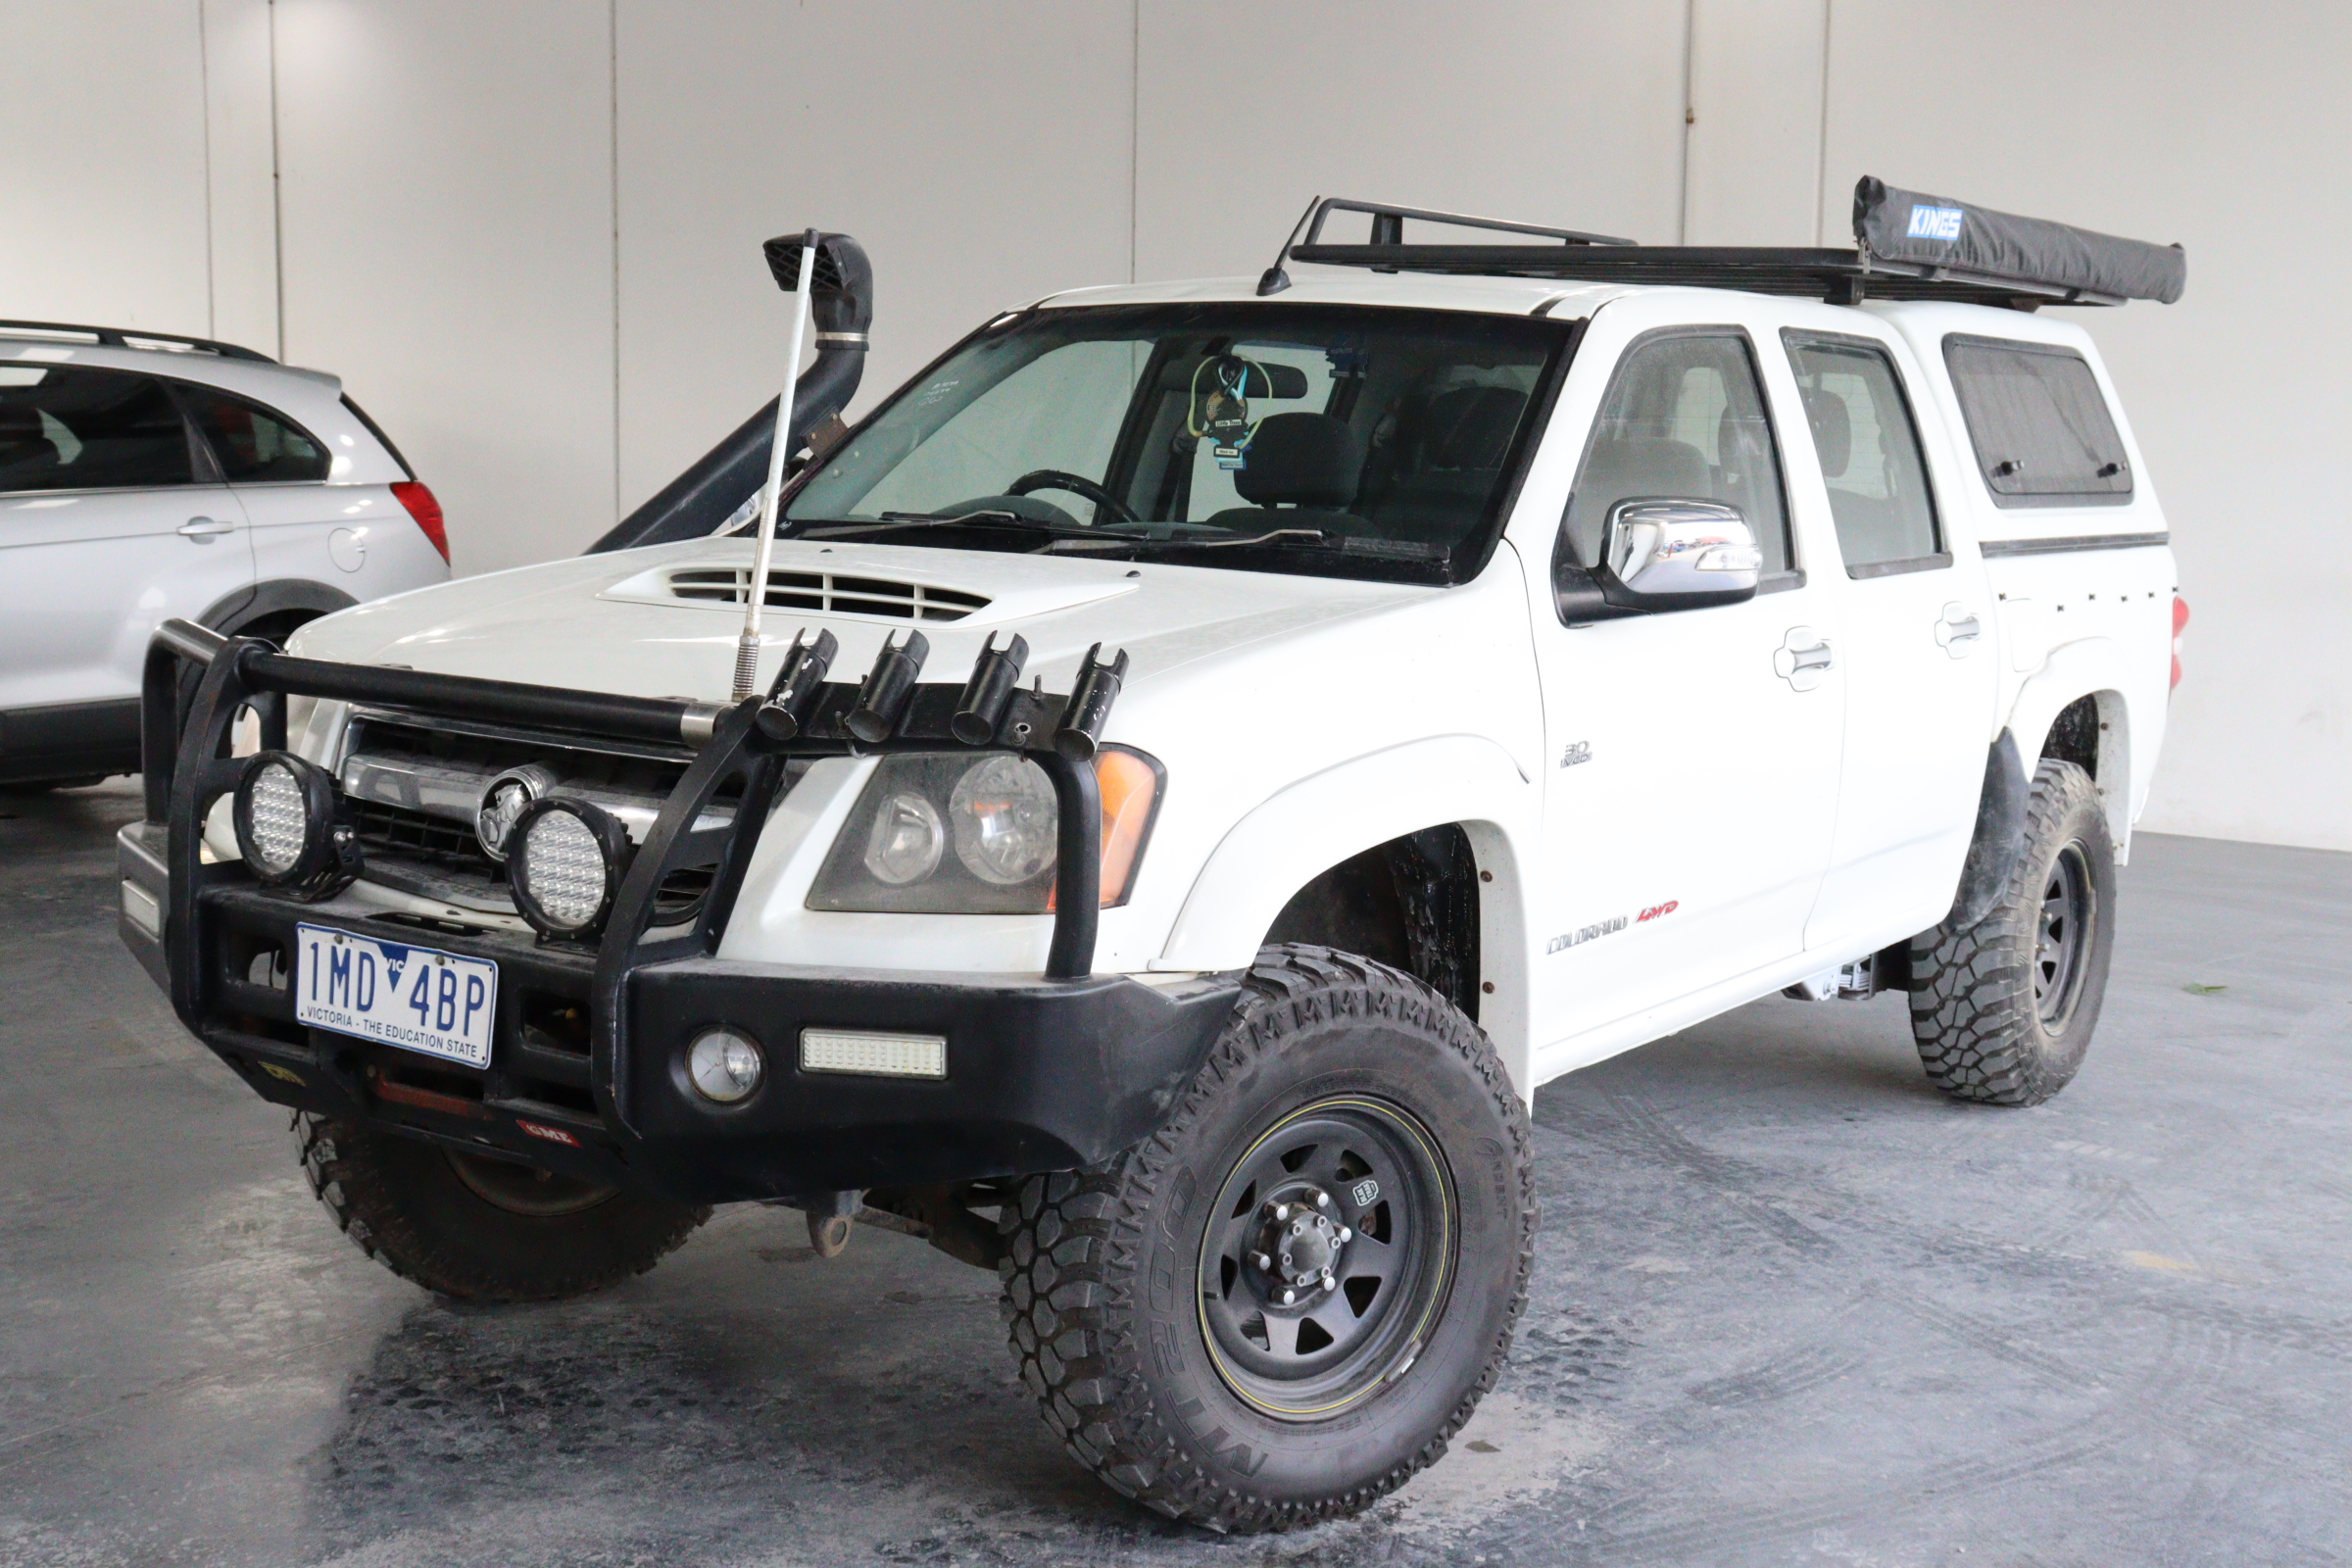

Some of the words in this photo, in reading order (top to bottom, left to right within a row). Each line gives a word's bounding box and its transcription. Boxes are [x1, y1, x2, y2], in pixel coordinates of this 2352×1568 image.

[1908, 208, 1961, 237] KINGS
[1546, 914, 1628, 955] COLORADO
[1635, 900, 1679, 923] 4WD
[387, 957, 405, 973] VIC
[307, 1005, 352, 1028] VICTORIA
[364, 1019, 382, 1035] THE
[385, 1024, 443, 1050] EDUCATION
[446, 1040, 477, 1057] STATE
[527, 1124, 572, 1144] GME
